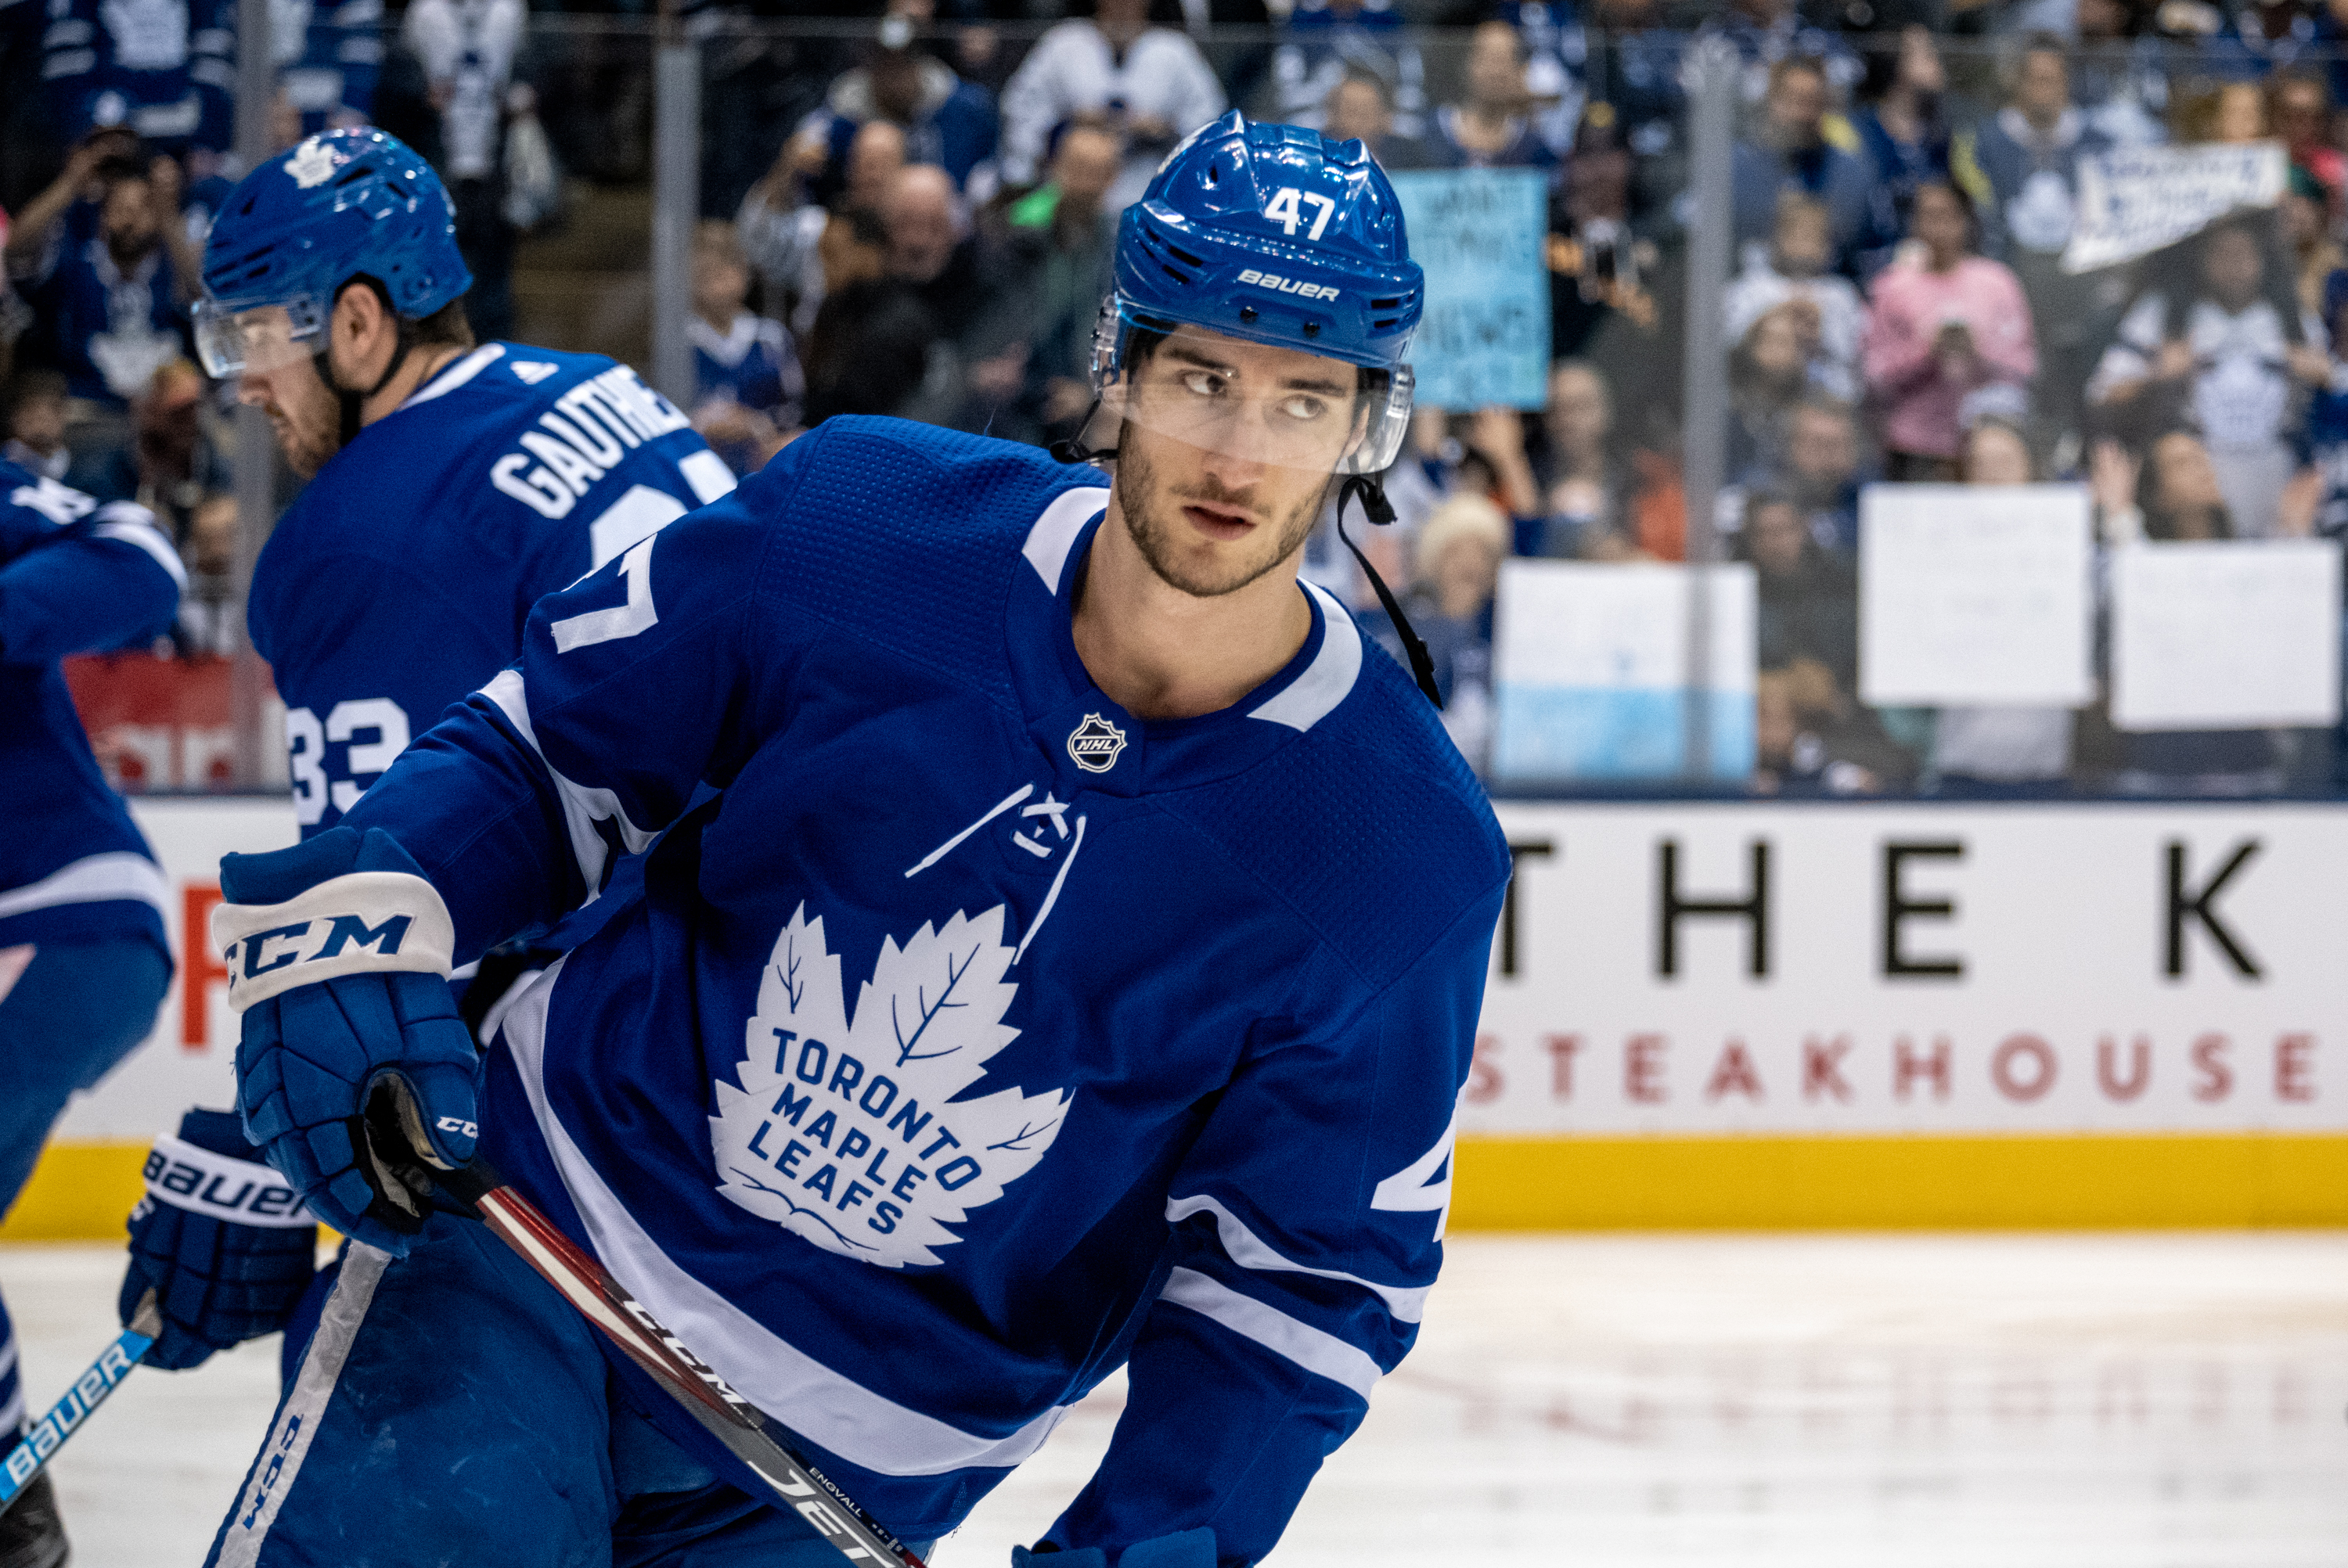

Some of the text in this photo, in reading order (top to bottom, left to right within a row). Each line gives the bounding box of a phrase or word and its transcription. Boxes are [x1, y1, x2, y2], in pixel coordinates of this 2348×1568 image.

[1265, 186, 1335, 241] 47
[1076, 739, 1113, 751] NHL
[1498, 840, 2265, 981] THE K
[772, 1027, 982, 1192] TORONTO
[1465, 1033, 2317, 1105] STEAKHOUSE
[747, 1120, 904, 1235] LEAFS
[771, 1081, 928, 1203] MAPLE
[623, 1300, 747, 1404] CCM
[809, 1466, 862, 1518] ENGVALL
